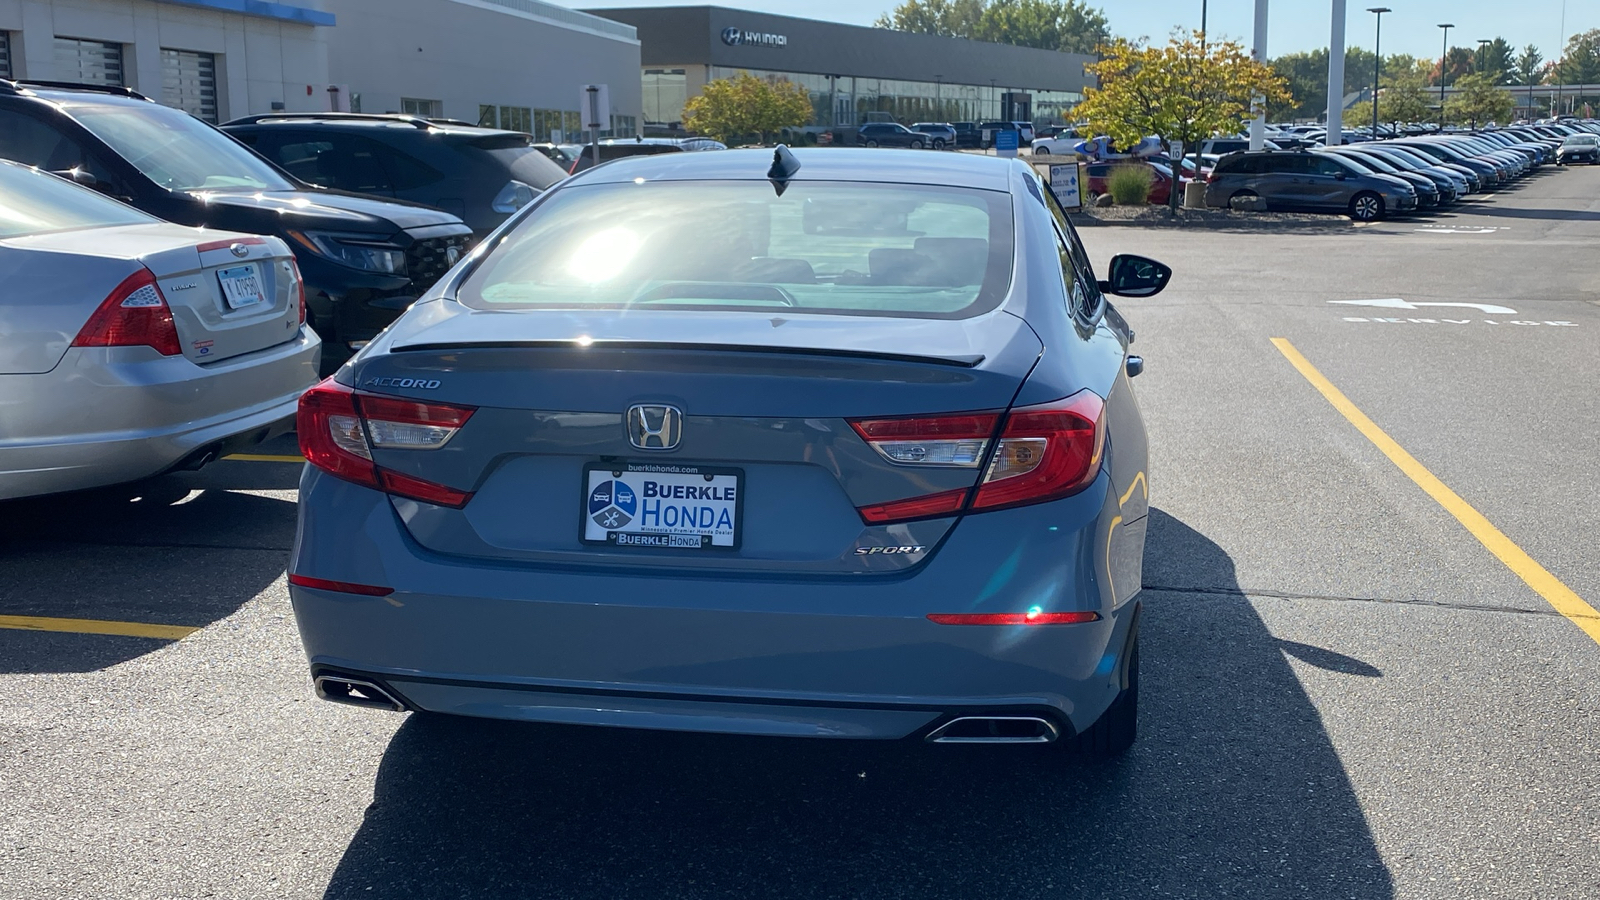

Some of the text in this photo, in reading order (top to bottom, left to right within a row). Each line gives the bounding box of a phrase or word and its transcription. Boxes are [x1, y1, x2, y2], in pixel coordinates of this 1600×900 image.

[745, 31, 787, 46] HYUNDAI
[1342, 317, 1579, 327] SERVICE
[365, 377, 441, 389] ACCORD
[628, 464, 698, 474] buerklehonda.com
[643, 481, 735, 501] BUERKLE
[641, 499, 733, 529] HONDA
[618, 533, 700, 547] BUERKLE HONDA
[853, 545, 926, 556] SPORT
